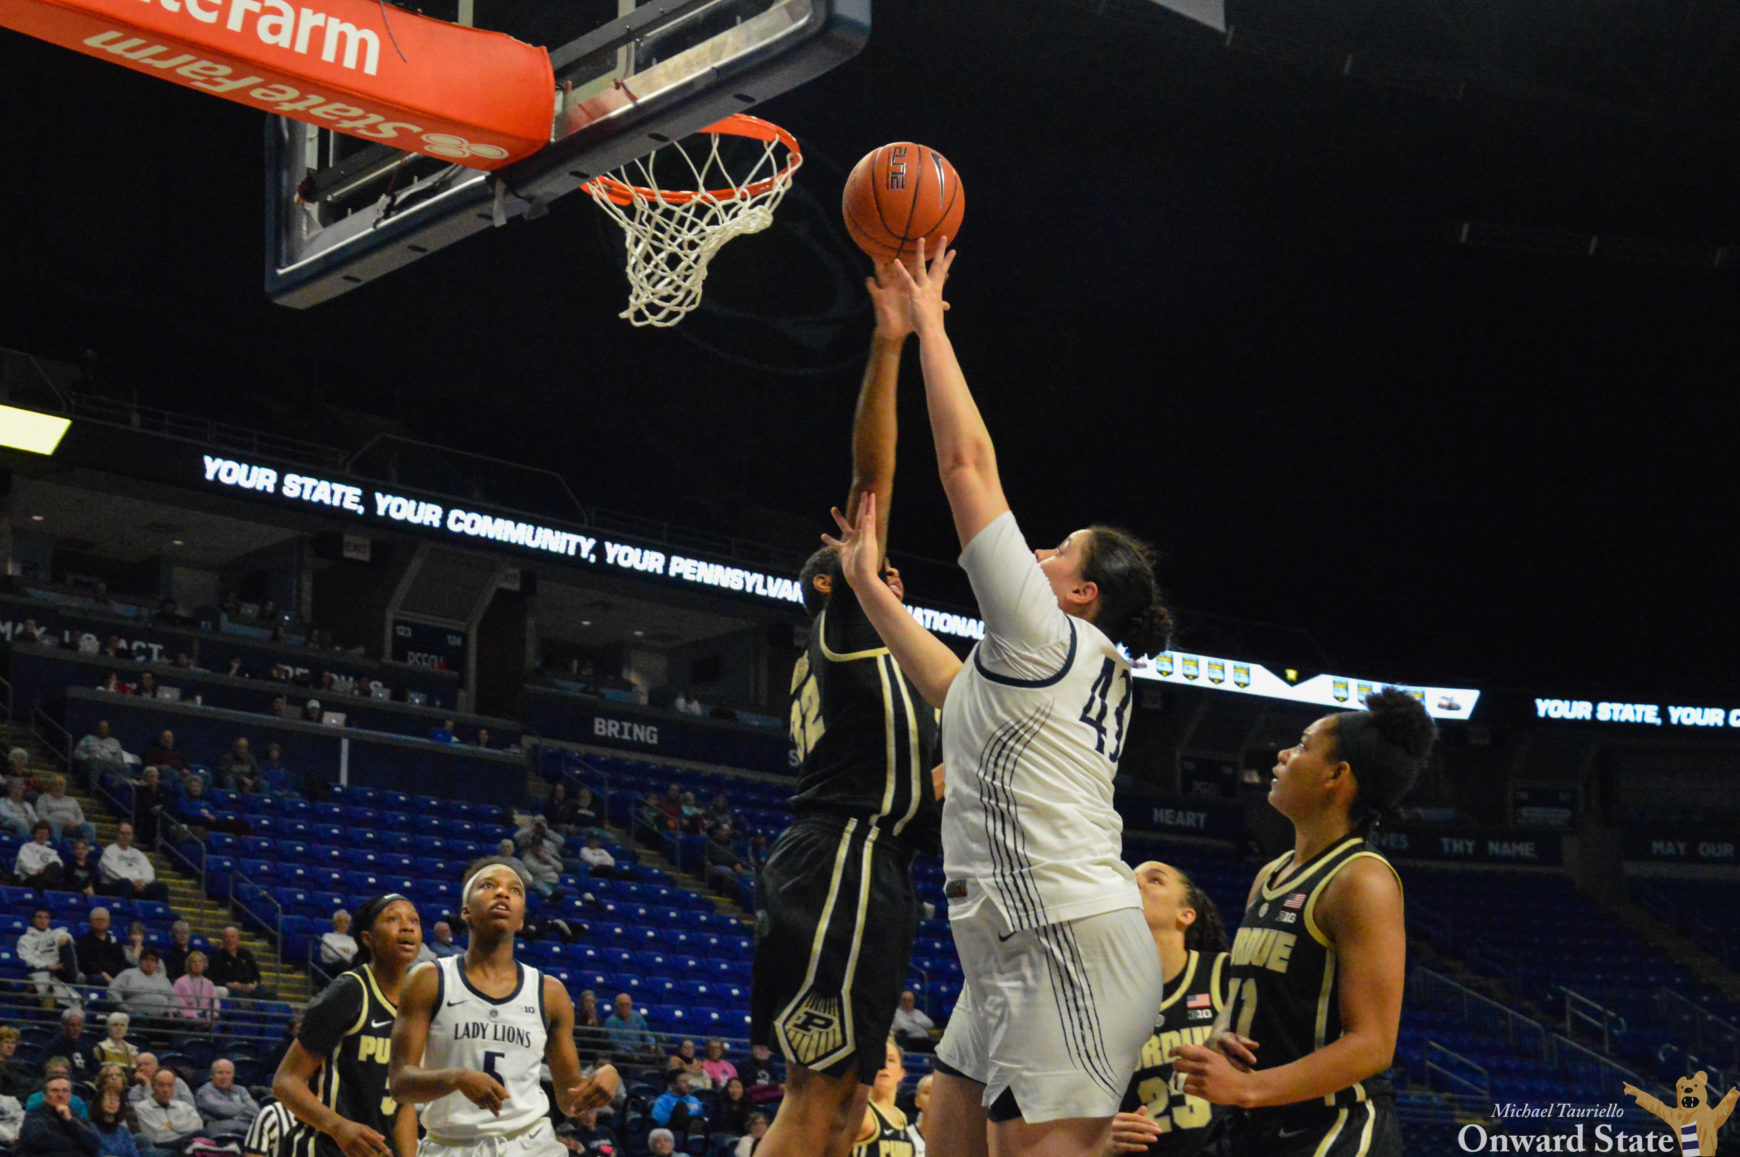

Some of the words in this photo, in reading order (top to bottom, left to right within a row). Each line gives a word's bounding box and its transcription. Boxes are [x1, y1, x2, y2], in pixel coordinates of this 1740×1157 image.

[203, 455, 278, 493] YOUR
[282, 473, 365, 515] STATE,
[374, 492, 443, 528] YOUR
[447, 509, 597, 563] COMMUNITY,
[604, 541, 665, 574] YOUR
[668, 555, 805, 604] PENNSYLVAN
[1535, 698, 1593, 721] YOUR
[1596, 702, 1662, 726] STATE,
[1668, 705, 1725, 727] YOUR
[594, 717, 658, 745] BRING
[1153, 807, 1208, 829] HEART
[1368, 831, 1409, 850] OVES
[1440, 837, 1476, 854] THY
[1487, 840, 1536, 857] NAME
[1651, 840, 1687, 856] MAY
[1699, 842, 1735, 857] OUR
[454, 1022, 488, 1041] LADY
[493, 1023, 531, 1048] LIONS
